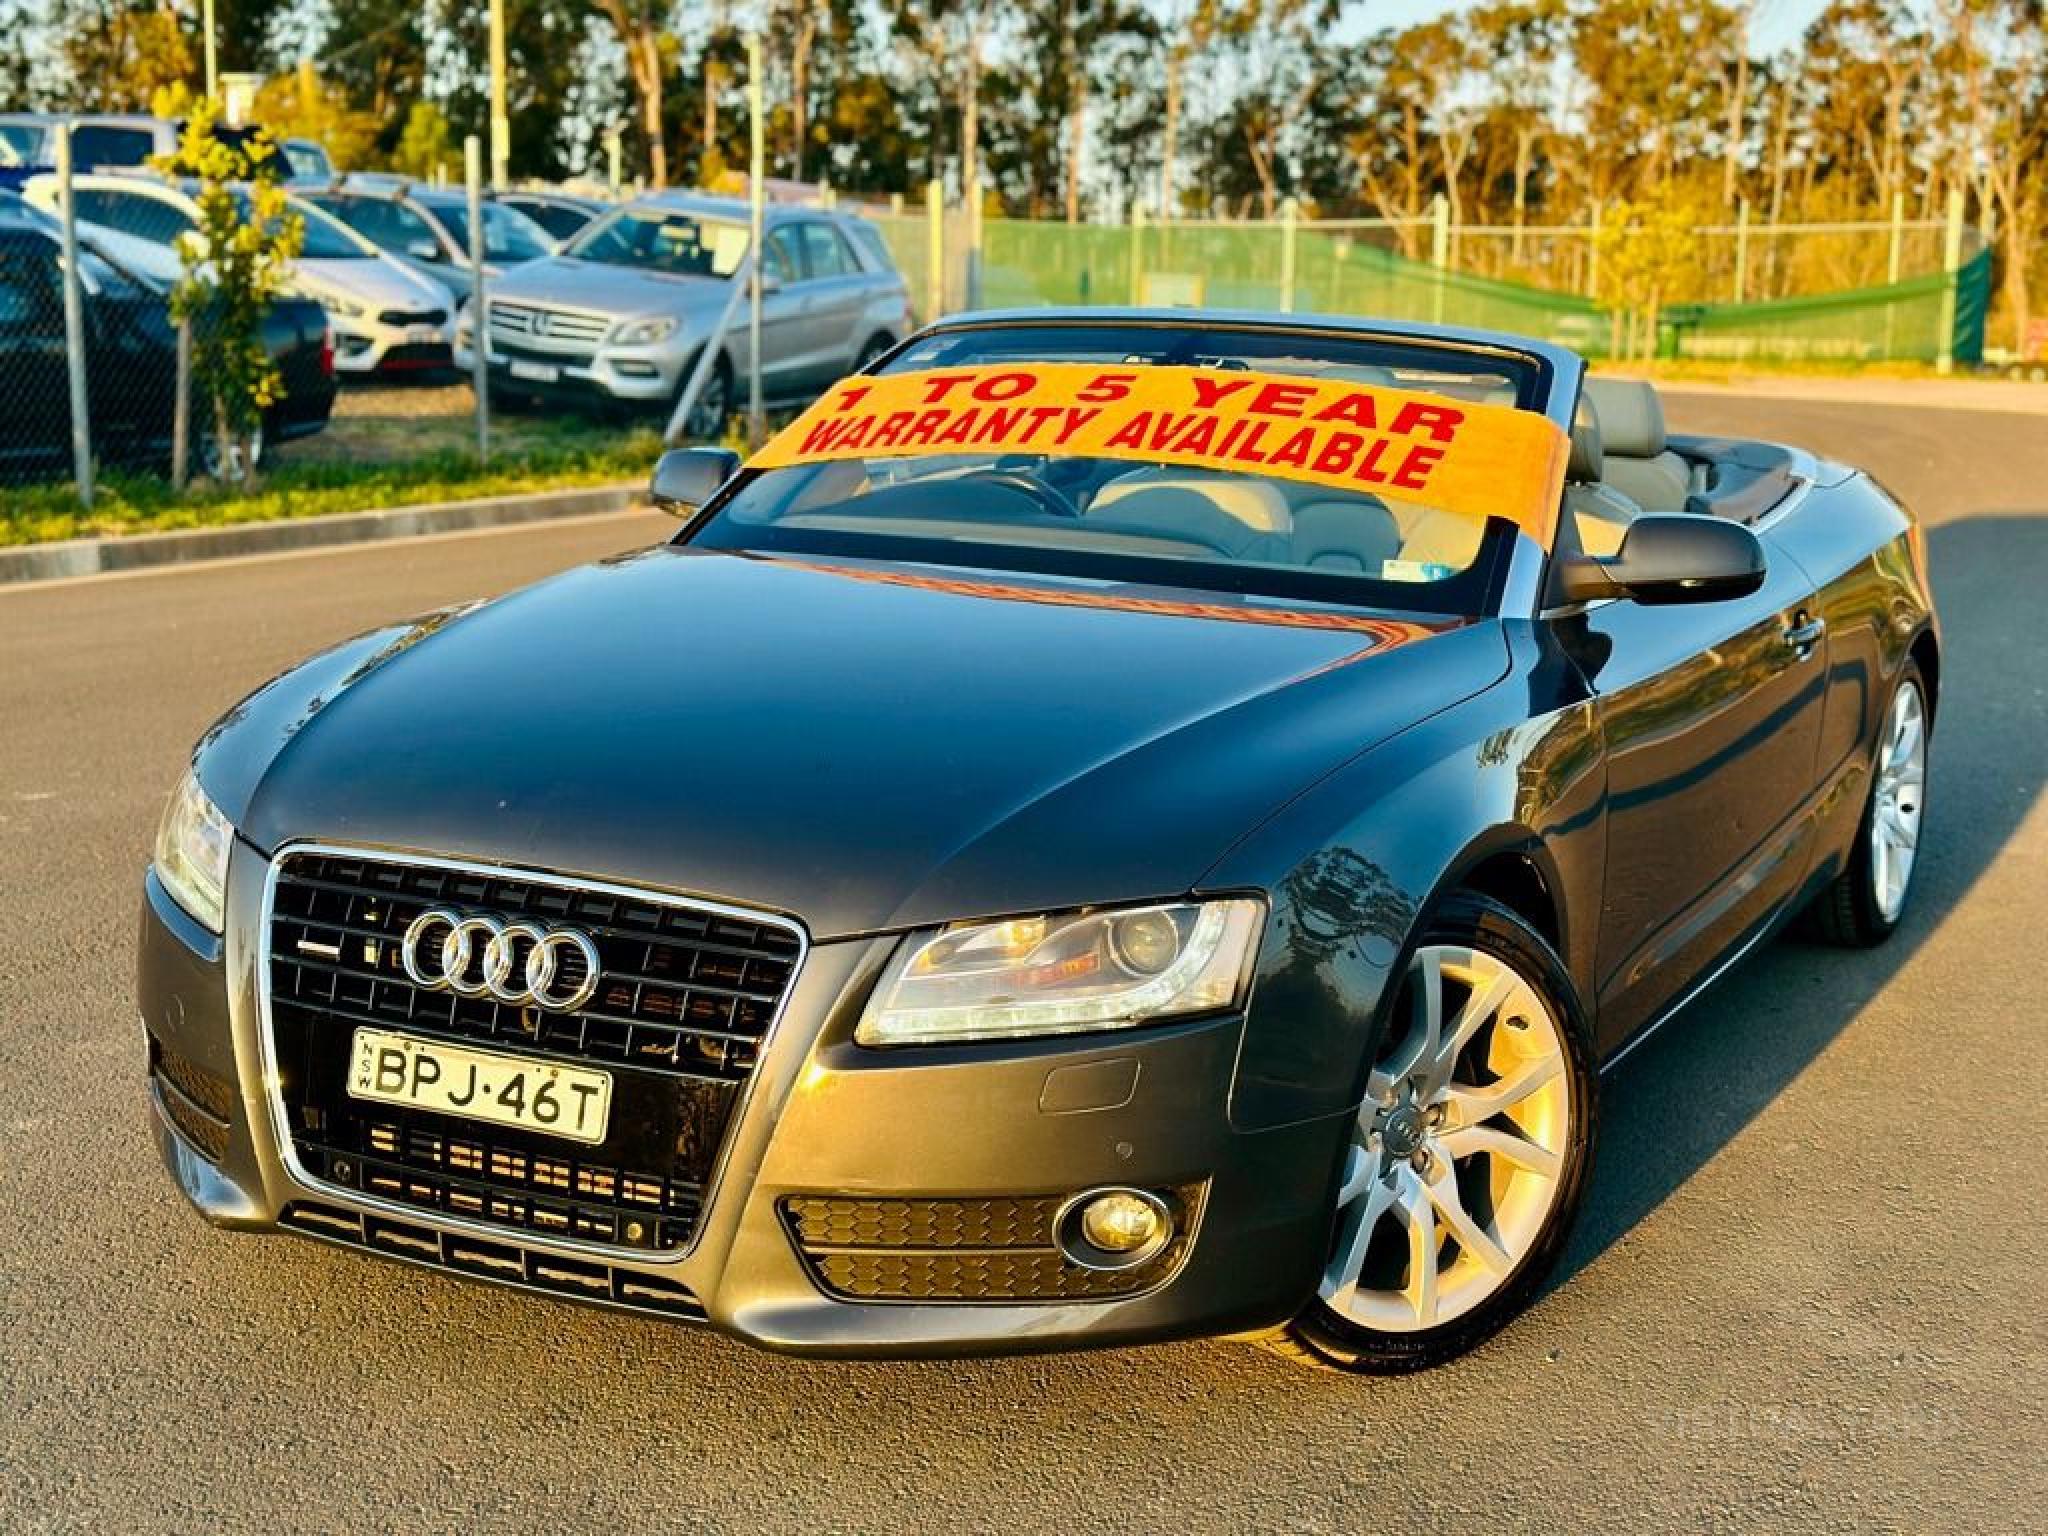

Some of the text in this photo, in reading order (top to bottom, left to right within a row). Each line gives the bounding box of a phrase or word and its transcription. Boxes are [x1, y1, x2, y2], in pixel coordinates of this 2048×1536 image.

[836, 375, 1466, 443] 1 TO 5 YEAR
[799, 407, 1447, 490] WARRANTY AVAILABLE
